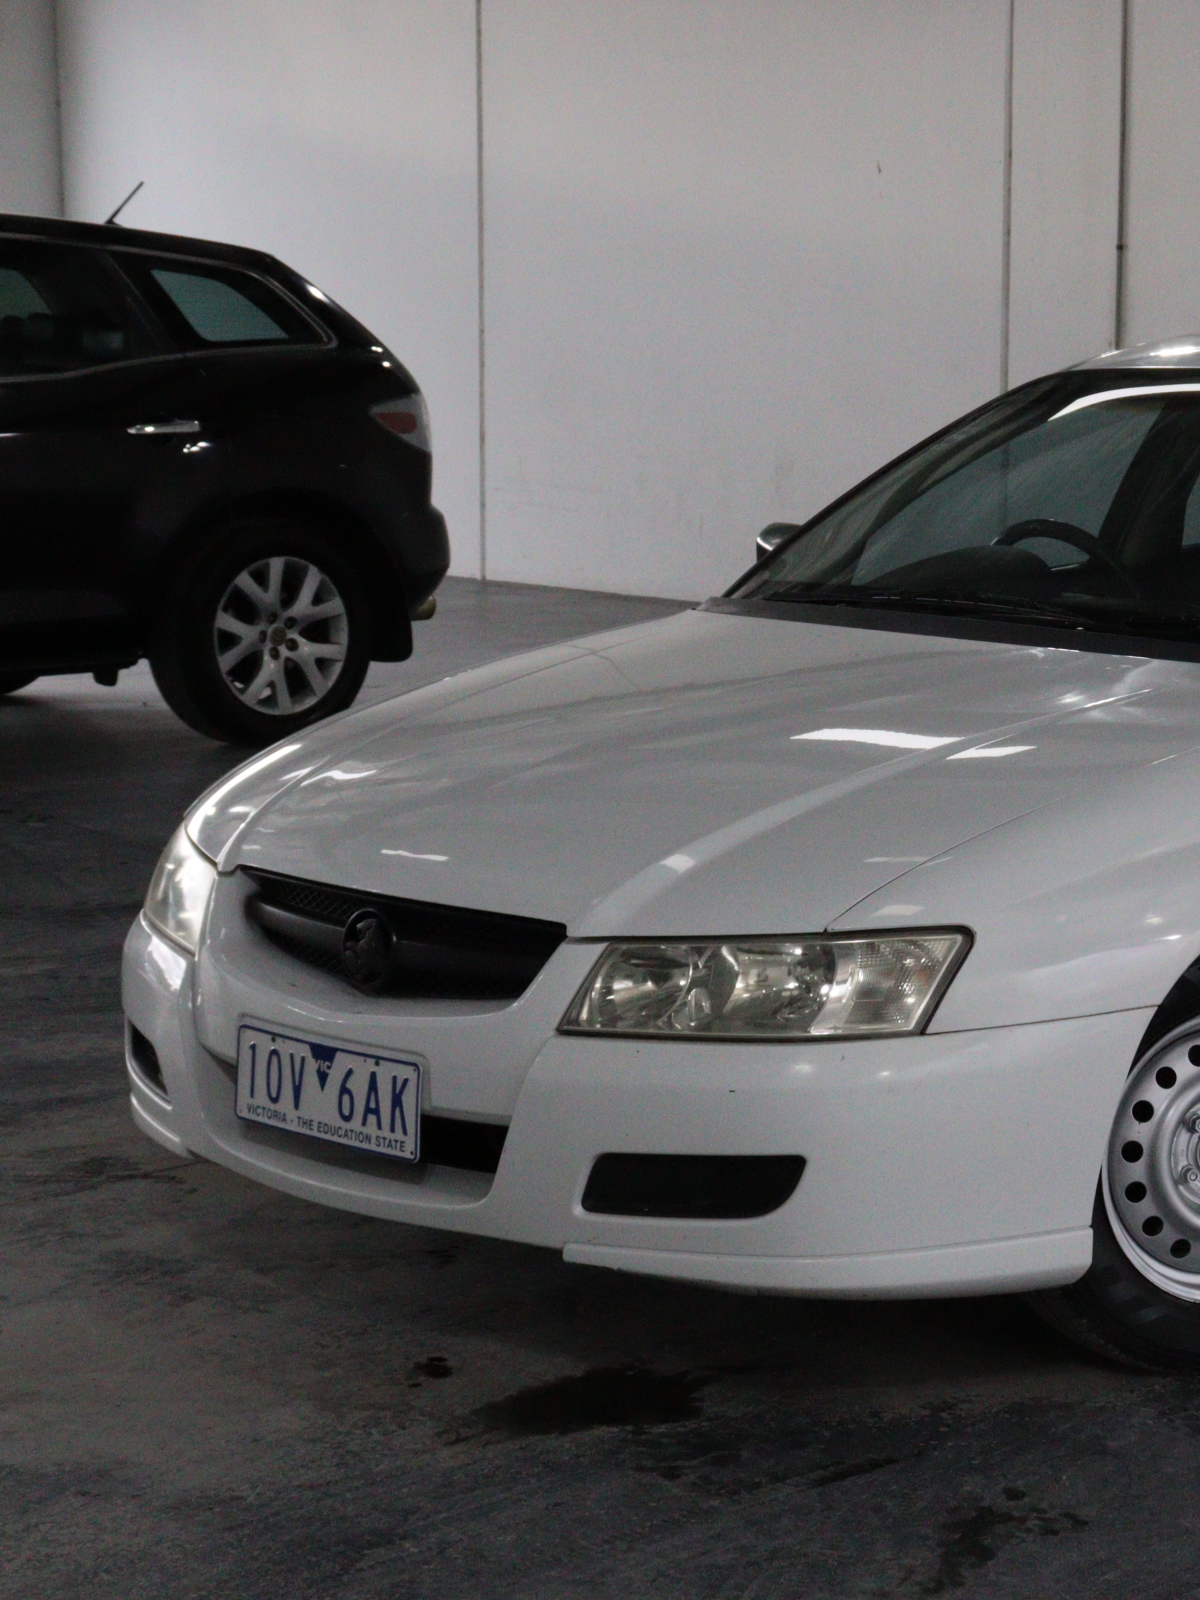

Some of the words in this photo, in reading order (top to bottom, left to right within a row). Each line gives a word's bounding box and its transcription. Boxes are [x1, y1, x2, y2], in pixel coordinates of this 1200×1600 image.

[315, 1060, 332, 1073] VIC
[337, 1065, 409, 1136] 6AK
[246, 1102, 288, 1123] VICTORIA
[296, 1115, 314, 1131] THE
[317, 1121, 372, 1145] EDUCATION
[375, 1135, 406, 1153] STATE
